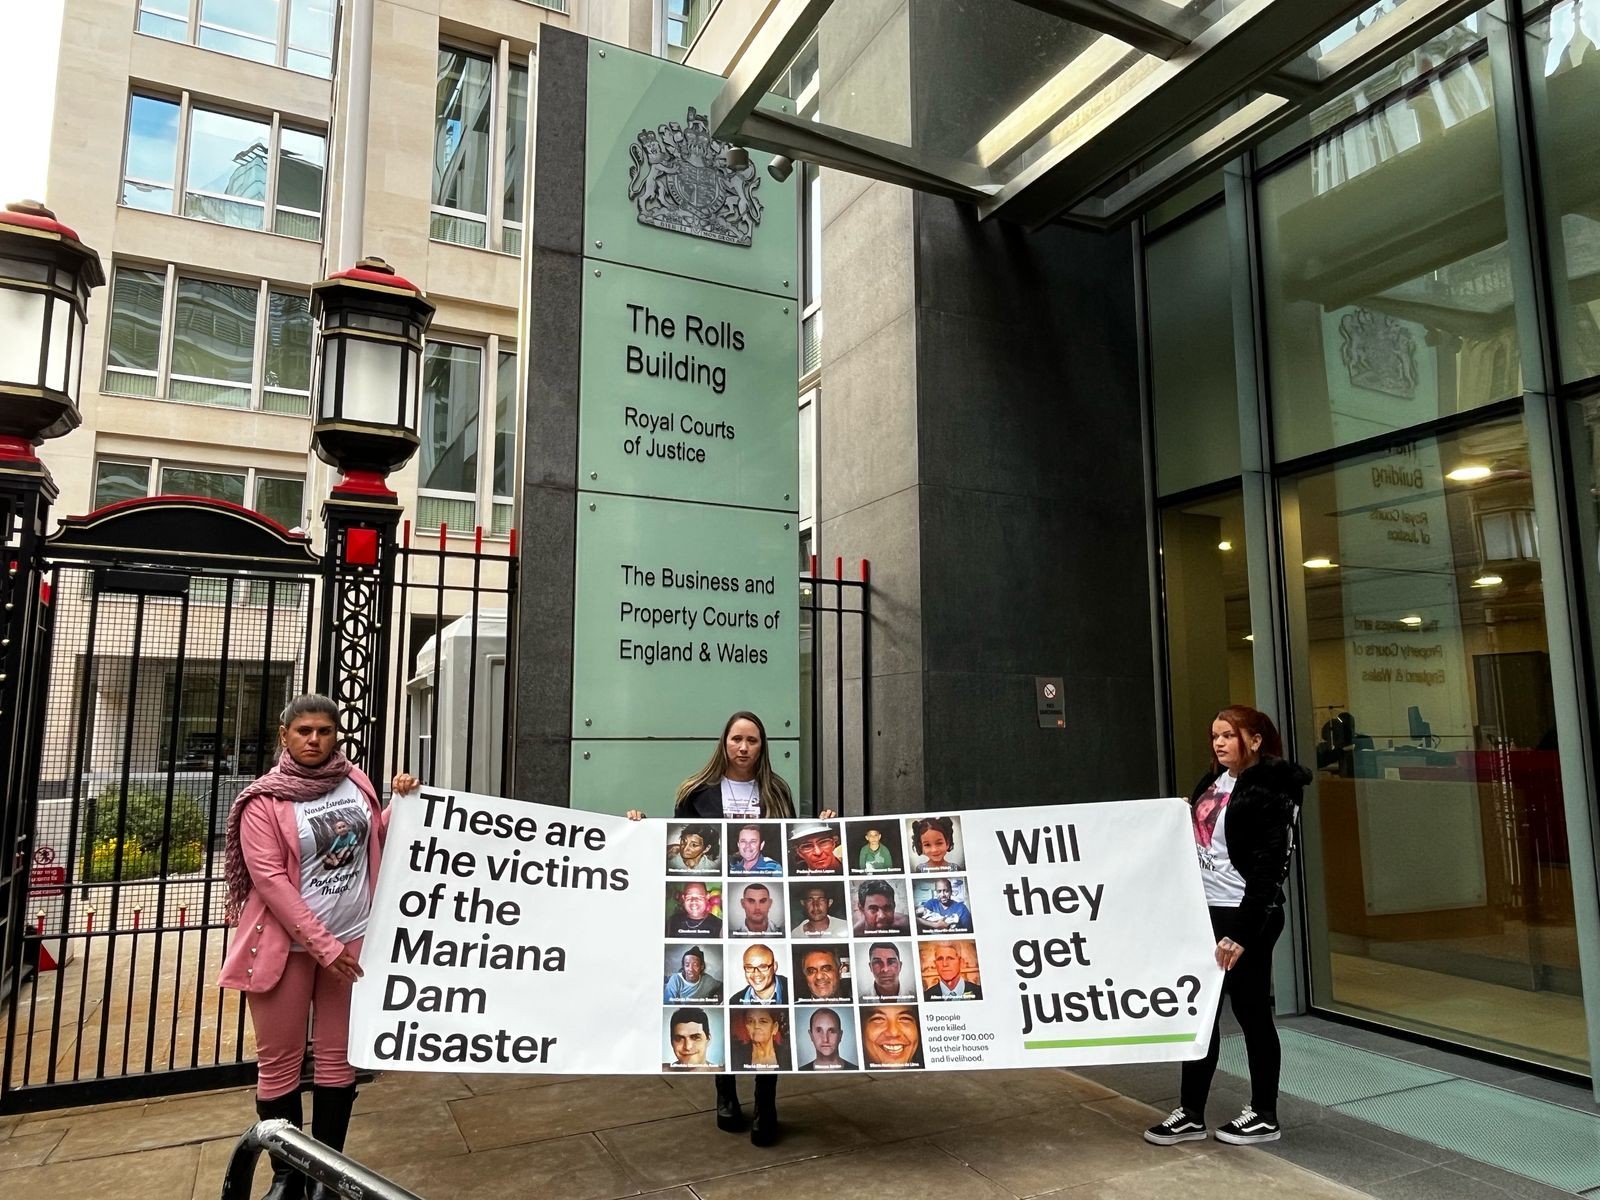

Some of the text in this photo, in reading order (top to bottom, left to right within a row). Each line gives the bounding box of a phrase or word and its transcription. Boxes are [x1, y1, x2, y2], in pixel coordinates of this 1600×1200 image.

[627, 304, 744, 351] The Rolls
[627, 346, 725, 394] Building
[625, 407, 735, 440] Royal Courts
[624, 436, 706, 463] of Justice
[621, 565, 775, 595] The Business and
[621, 602, 781, 631] Property Courts of
[620, 639, 768, 666] England & Wales
[419, 792, 606, 851] These are
[409, 837, 630, 891] the victims
[995, 824, 1081, 866] Will
[309, 877, 331, 888] Para
[1003, 877, 1104, 921] they
[398, 883, 521, 926] of the
[390, 927, 566, 972] Mariana
[1012, 931, 1091, 979] get
[382, 974, 487, 1014] Dam
[1018, 974, 1201, 1035] justice?
[928, 1034, 942, 1042] and
[961, 1032, 995, 1041] 700,000
[936, 1013, 961, 1022] people
[946, 1023, 966, 1031] killed
[373, 1020, 557, 1064] disaster
[929, 1043, 989, 1053] lost their houses
[931, 1055, 945, 1063] and
